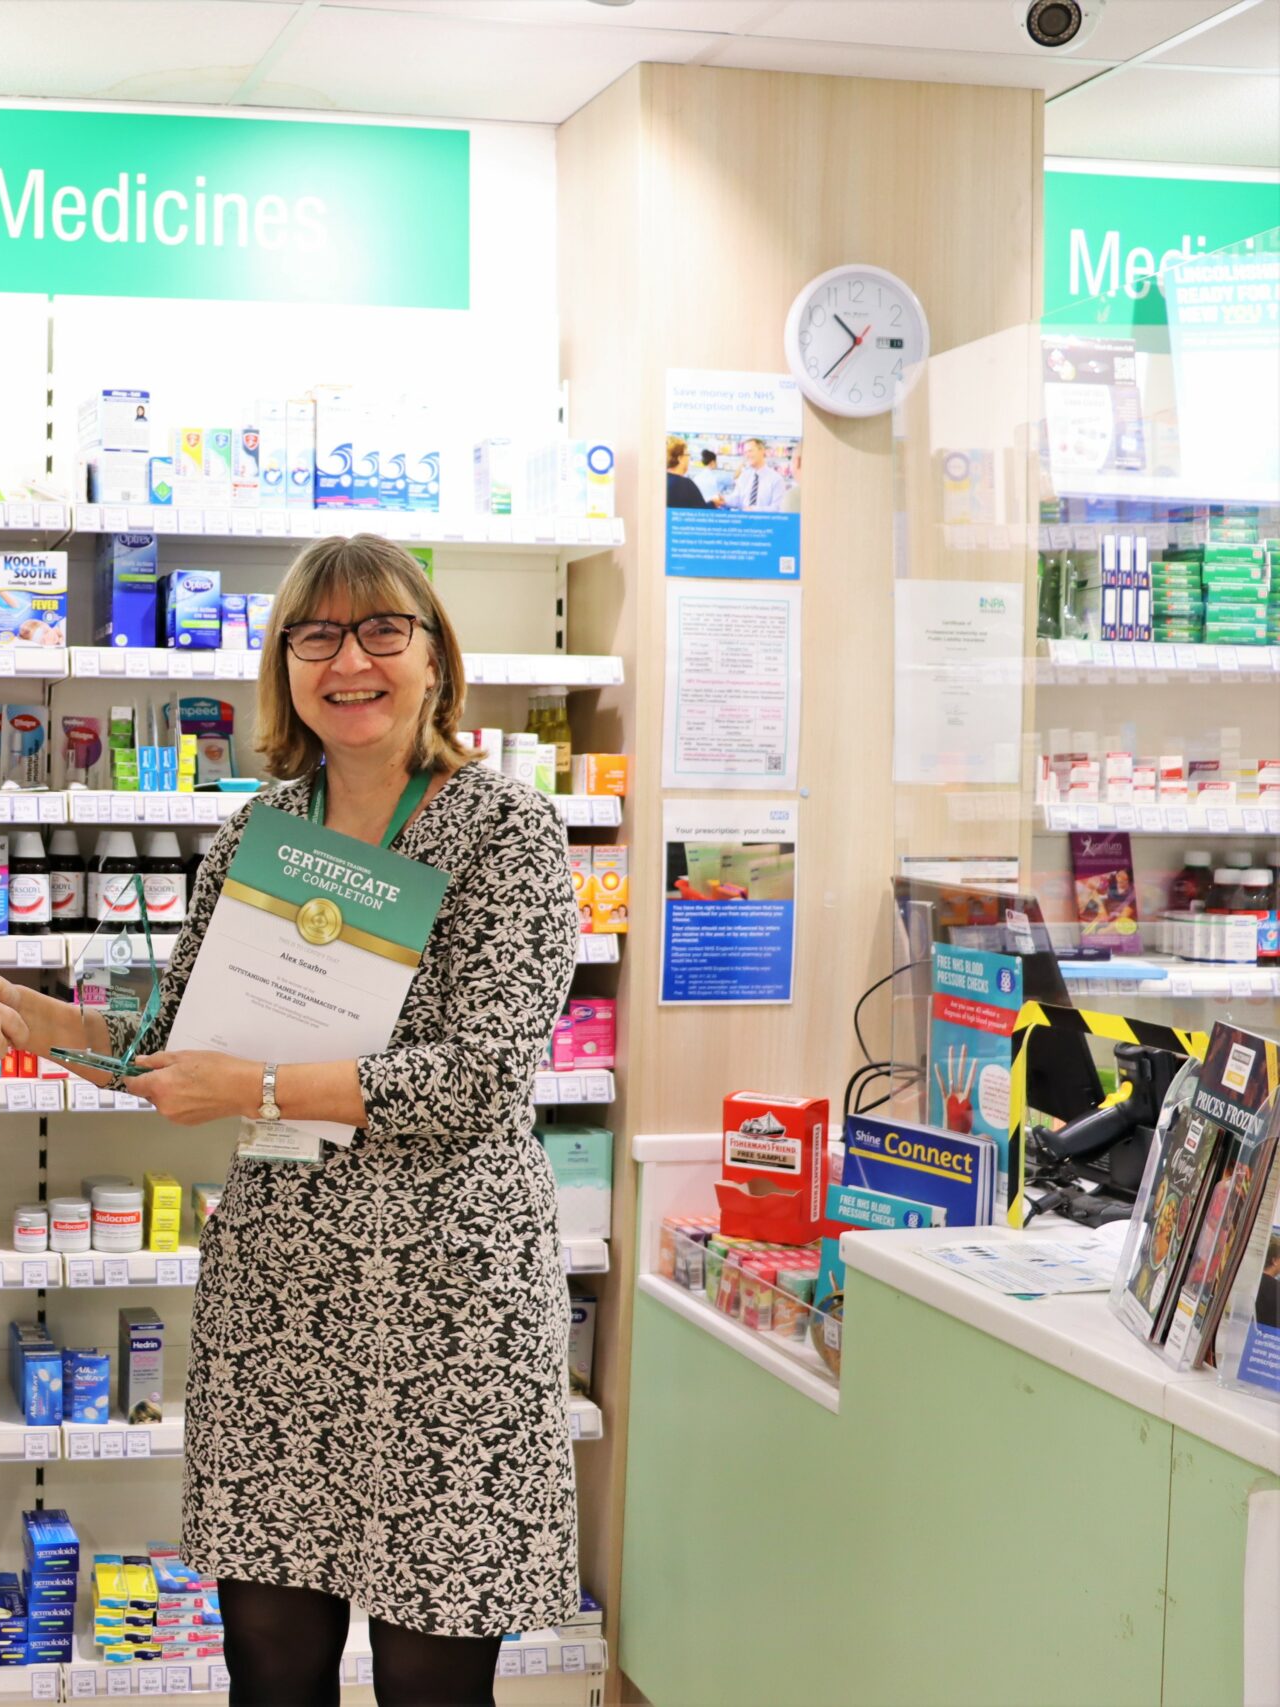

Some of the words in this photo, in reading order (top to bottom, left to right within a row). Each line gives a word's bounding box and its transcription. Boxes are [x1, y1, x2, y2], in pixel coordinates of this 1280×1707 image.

[827, 286, 838, 307] 11
[848, 280, 864, 303] 12
[878, 287, 882, 308] 1
[808, 304, 826, 328] 10
[890, 304, 902, 327] 2
[808, 356, 819, 379] 8
[701, 389, 735, 400] money
[738, 391, 750, 399] on
[753, 391, 775, 400] NHS
[848, 383, 862, 403] 6
[872, 376, 886, 398] 5
[672, 400, 733, 412] prescription
[736, 403, 775, 414] charges
[14, 568, 57, 579] SOOTHE
[183, 579, 213, 592] Optrex
[32, 600, 58, 610] FEVER
[278, 845, 400, 902] CERTIFICATE
[283, 865, 300, 878] OF
[302, 873, 384, 911] COMPLETION
[280, 952, 297, 964] Alex
[298, 958, 327, 976] Scarbro
[937, 955, 951, 969] FREE
[965, 960, 984, 976] BLOOD
[228, 964, 270, 986] OUTSTANDING
[271, 980, 297, 996] TRAINEE
[298, 992, 337, 1012] PHARMACIST
[338, 1007, 346, 1015] OF
[347, 1011, 360, 1020] THE
[937, 971, 966, 989] PRESSURE
[967, 977, 989, 994] CHECKS
[275, 991, 292, 1003] YEAR
[292, 997, 307, 1008] 2023
[1195, 1090, 1225, 1118] PRICES
[1225, 1104, 1264, 1136] FROZEN
[730, 1138, 770, 1152] FISHERMAN'S
[771, 1143, 796, 1154] FRIEND
[737, 1150, 755, 1159] FREE
[757, 1152, 787, 1162] SAMPLE
[856, 1130, 881, 1146] Shine
[884, 1133, 973, 1173] Connect
[840, 1195, 855, 1207] FREE
[856, 1197, 869, 1209] NHS
[870, 1200, 891, 1215] BLOOD
[56, 1222, 88, 1230] Sudocrem
[95, 1213, 137, 1223] Sudocrem
[838, 1206, 869, 1221] PRESSURE
[870, 1211, 895, 1227] CHECKS
[132, 1340, 158, 1350] Hedrin
[37, 1548, 77, 1558] germoloids
[34, 1579, 75, 1589] germoloids
[30, 1609, 72, 1620] germoloids
[30, 1639, 70, 1650] germoloids
